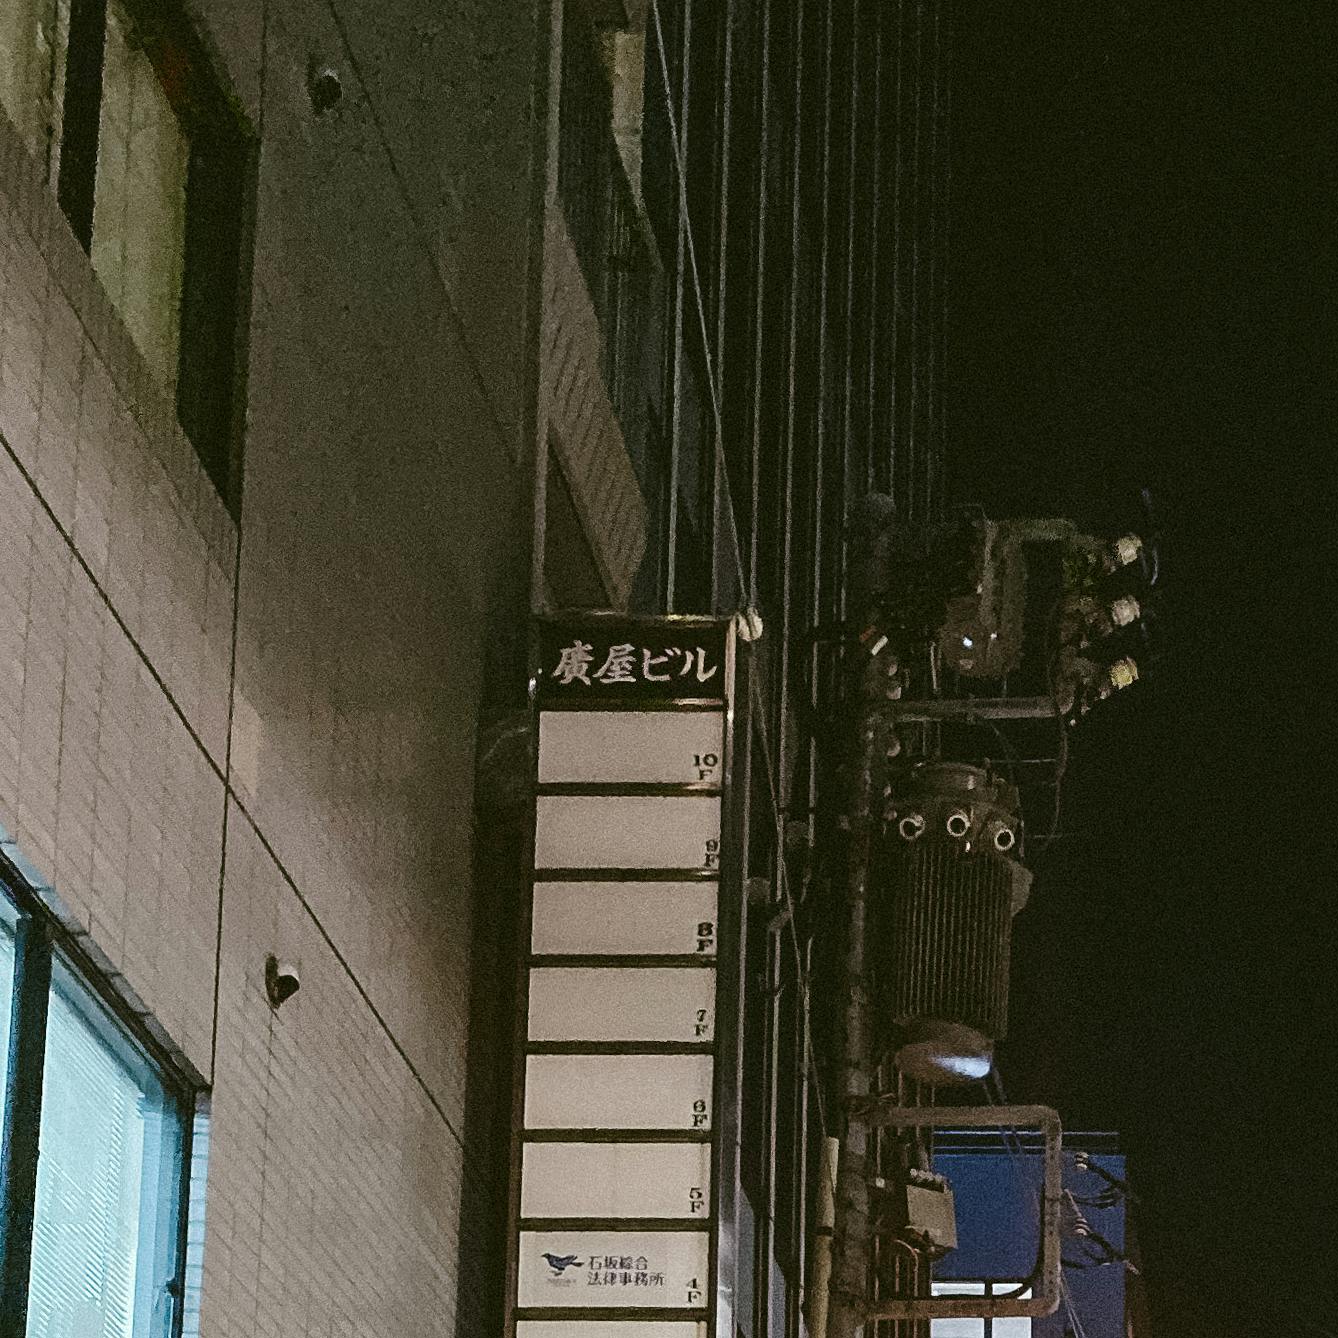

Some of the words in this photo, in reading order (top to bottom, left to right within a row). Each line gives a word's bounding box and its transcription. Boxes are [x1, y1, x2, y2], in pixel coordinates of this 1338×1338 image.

[587, 1272, 665, 1287] 法律事務所
